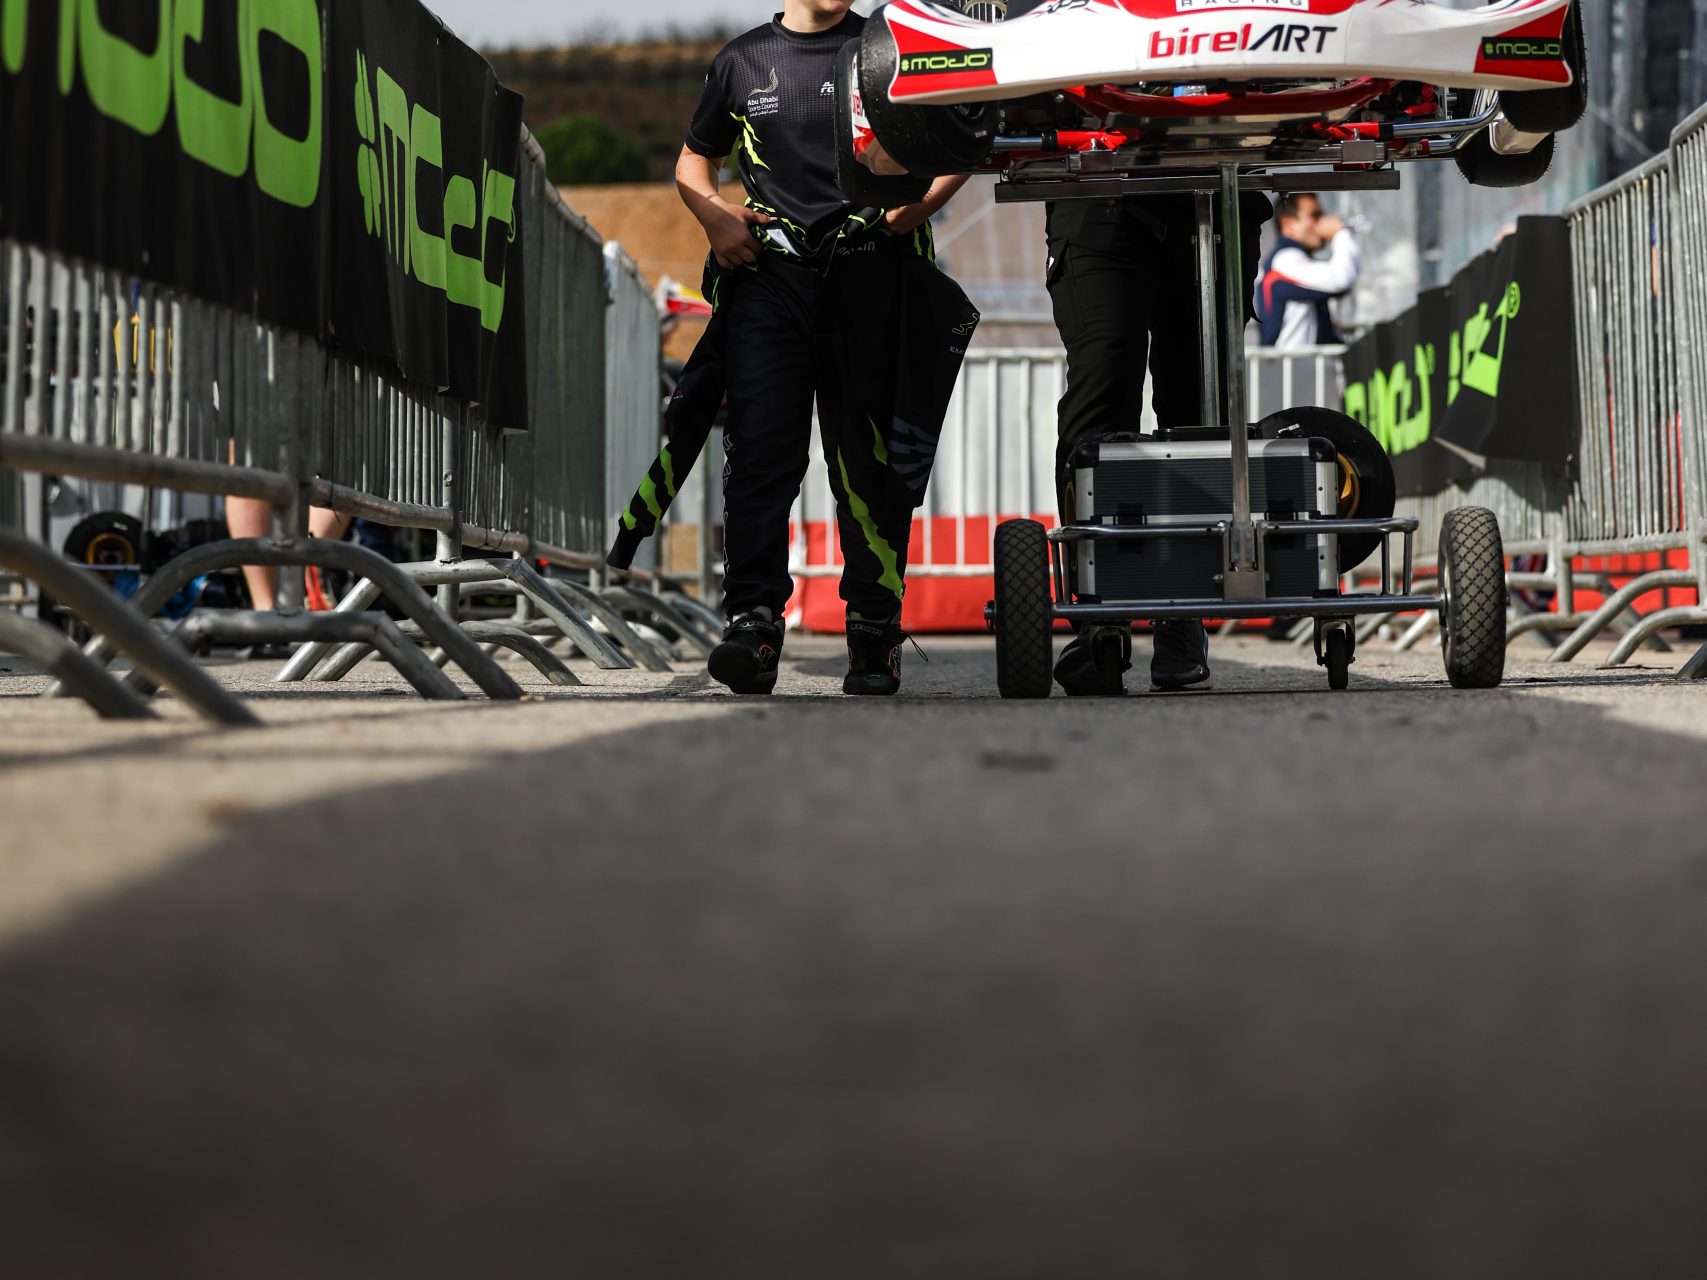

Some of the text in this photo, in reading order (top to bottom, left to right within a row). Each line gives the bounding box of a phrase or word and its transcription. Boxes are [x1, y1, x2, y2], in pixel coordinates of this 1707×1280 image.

[1495, 42, 1561, 56] MOJO
[910, 53, 988, 71] MOJO
[747, 95, 779, 107] Abu Dhabi
